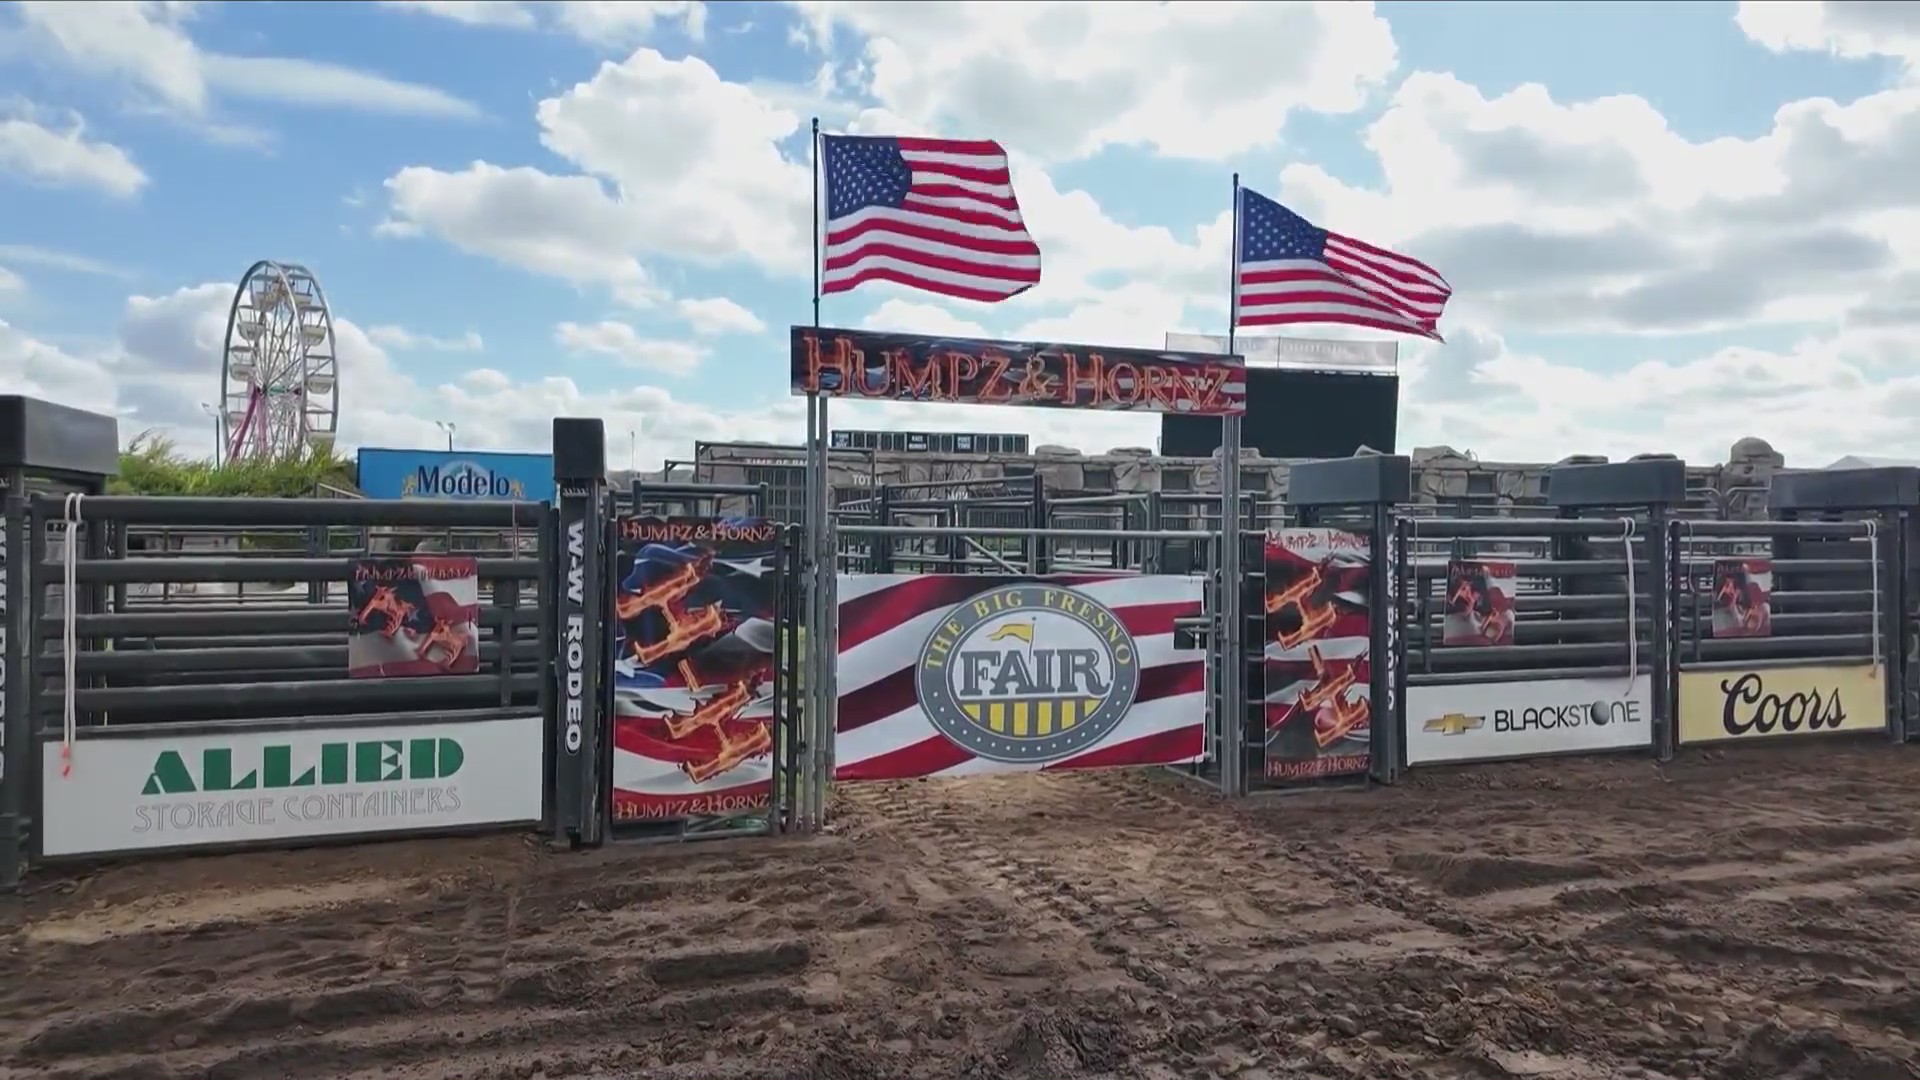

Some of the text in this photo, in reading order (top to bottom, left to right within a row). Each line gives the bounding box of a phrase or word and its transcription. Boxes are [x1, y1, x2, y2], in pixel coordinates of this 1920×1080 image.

[802, 334, 1231, 412] HUMPZ & HORNZ
[417, 465, 510, 496] Modelo
[622, 520, 775, 543] HUMPZ & HORNZ
[567, 518, 585, 607] W-W
[925, 590, 1132, 670] THE BIG FRESNO
[565, 613, 584, 755] RODEO
[959, 648, 1112, 699] FAIR
[1494, 700, 1641, 732] BLACKSTONE
[1720, 673, 1847, 735] Coors
[141, 738, 464, 795] ALLIED
[1327, 755, 1368, 773] HORNZ
[132, 786, 462, 833] STORAGE CONTAINERS
[616, 800, 688, 820] HUMPZ
[704, 793, 770, 815] HORNZ
